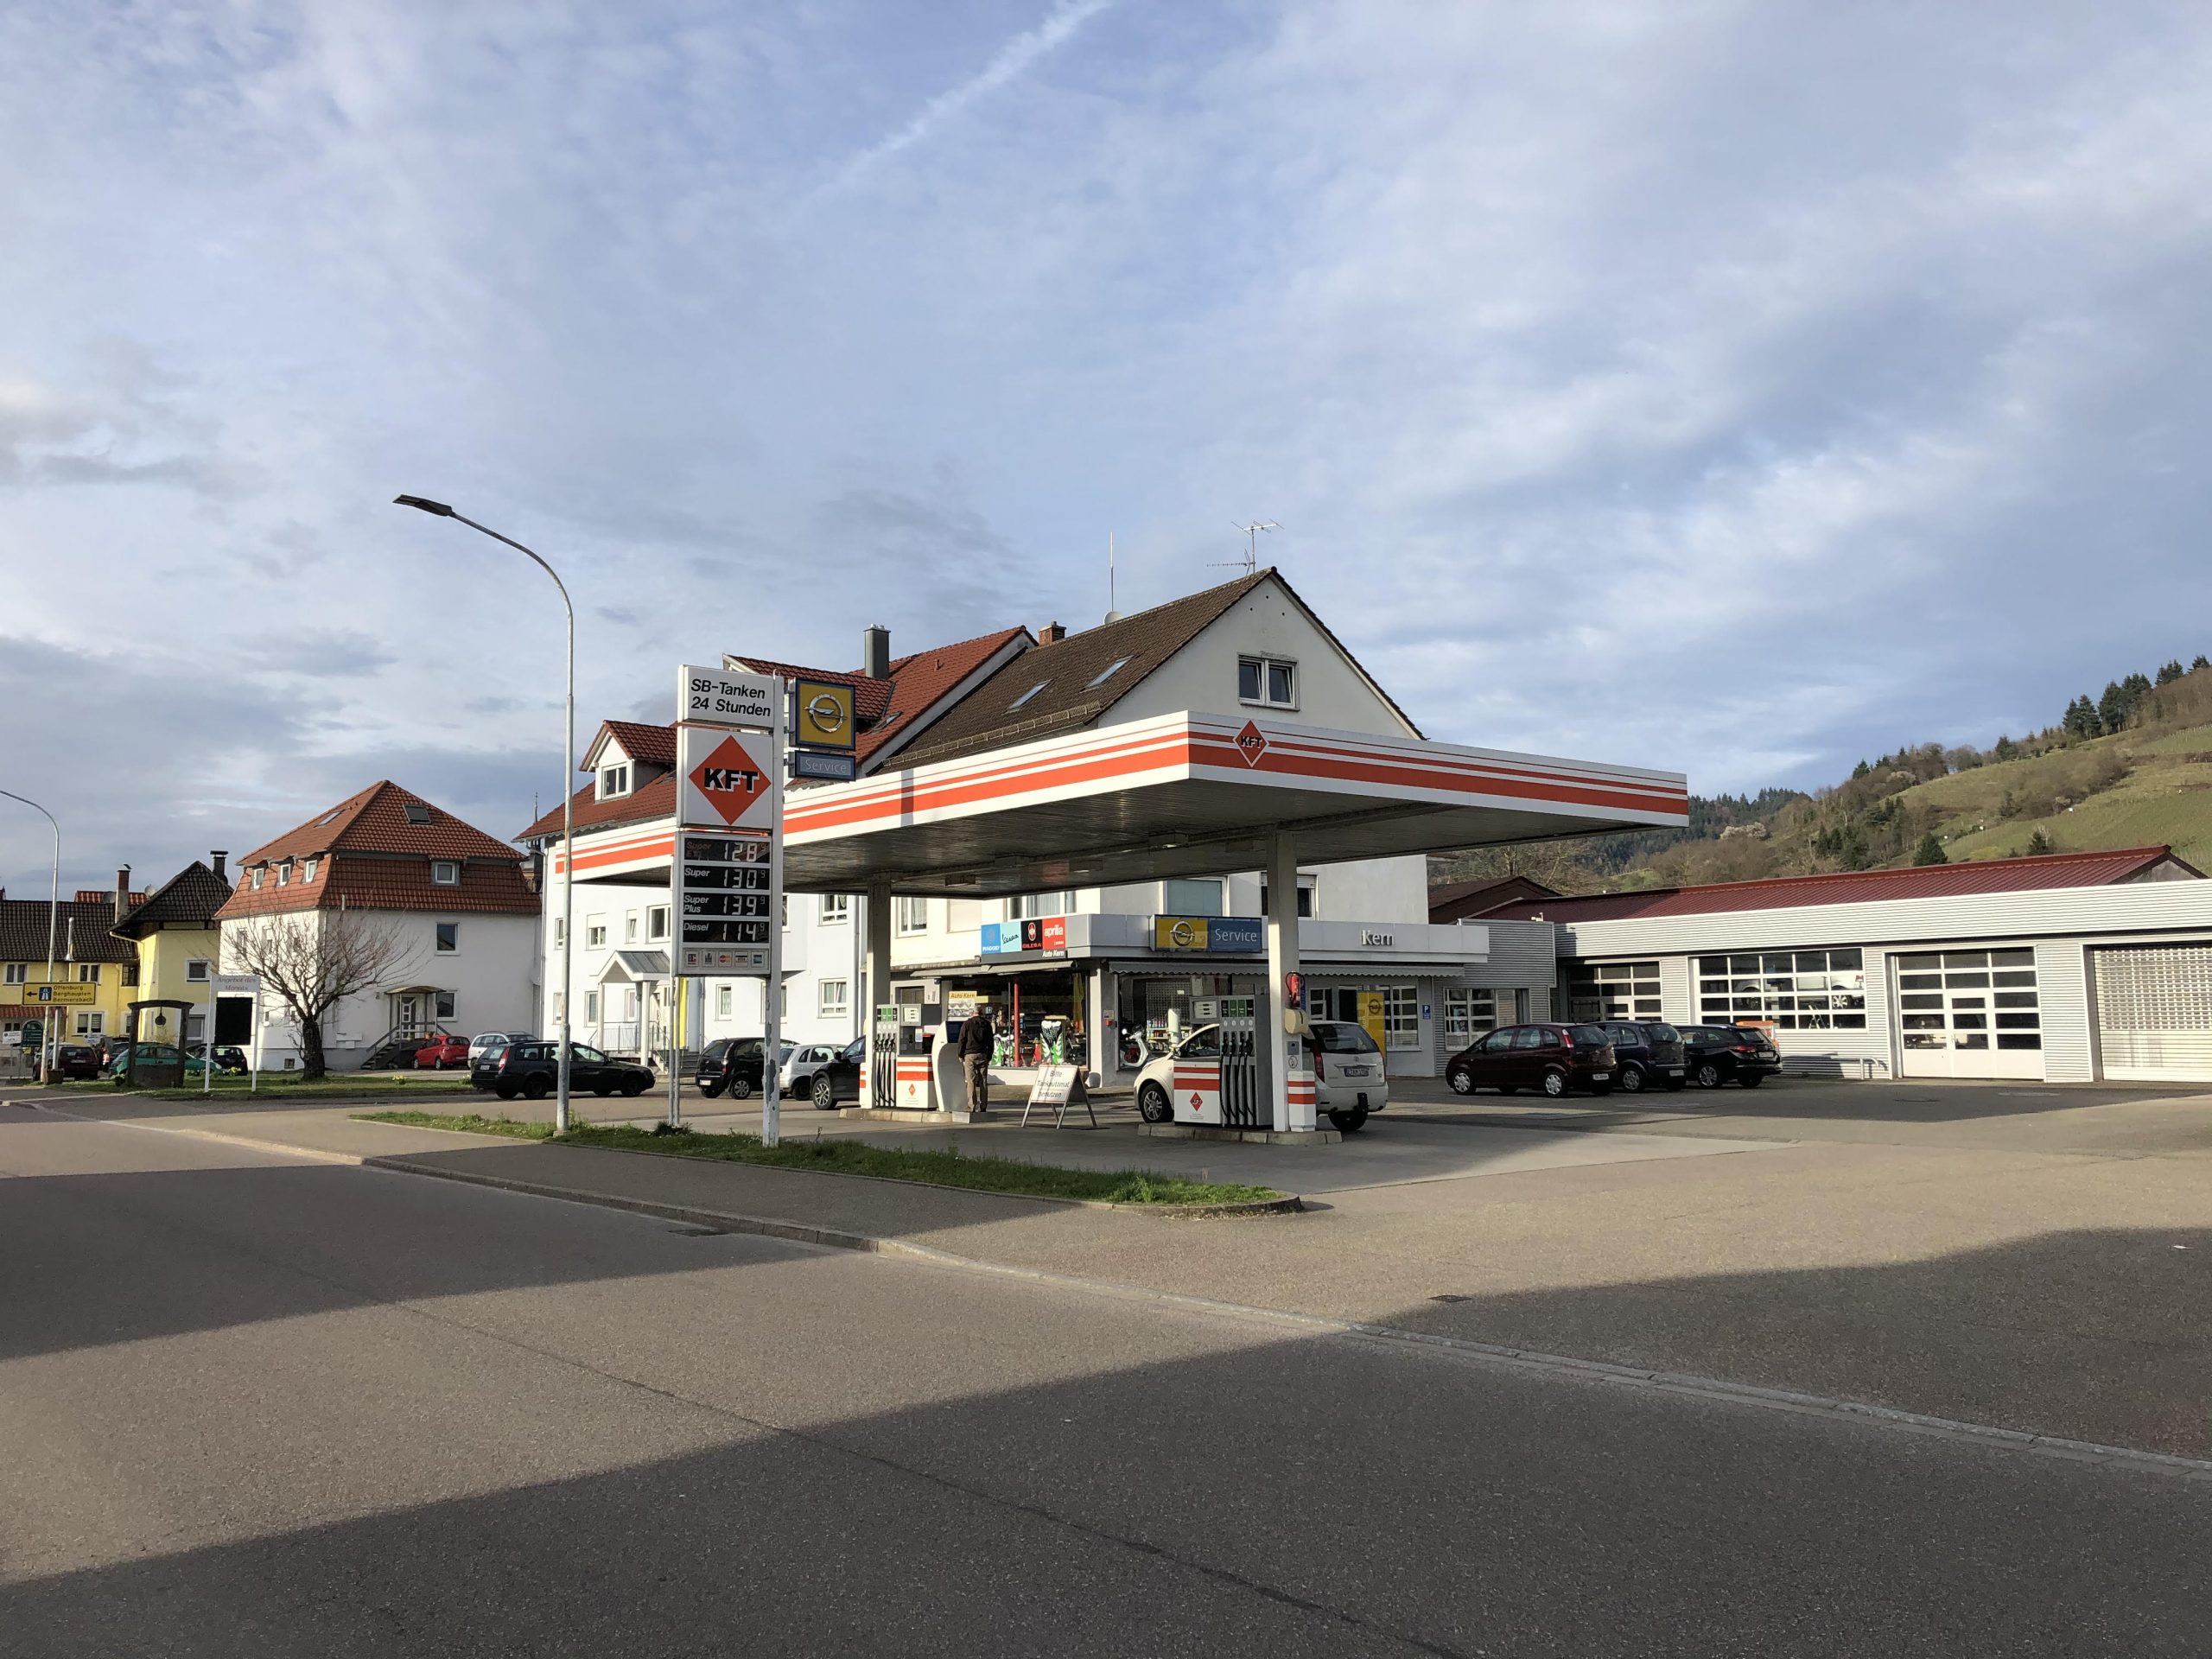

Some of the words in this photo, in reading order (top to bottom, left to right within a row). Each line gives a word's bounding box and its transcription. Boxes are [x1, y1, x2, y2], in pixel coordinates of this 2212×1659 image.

[691, 678, 766, 699] SB-Tanken
[691, 696, 709, 709] 24
[715, 699, 771, 716] Stunden
[1241, 736, 1262, 748] KFT
[805, 759, 847, 773] Service
[704, 767, 760, 794] KFT
[686, 842, 711, 851] Super
[684, 868, 710, 878] Super
[683, 895, 709, 905] Super
[1045, 925, 1064, 938] aprilia
[1215, 928, 1257, 942] Service
[1362, 930, 1395, 945] Kern
[1002, 934, 1020, 944] Vespa
